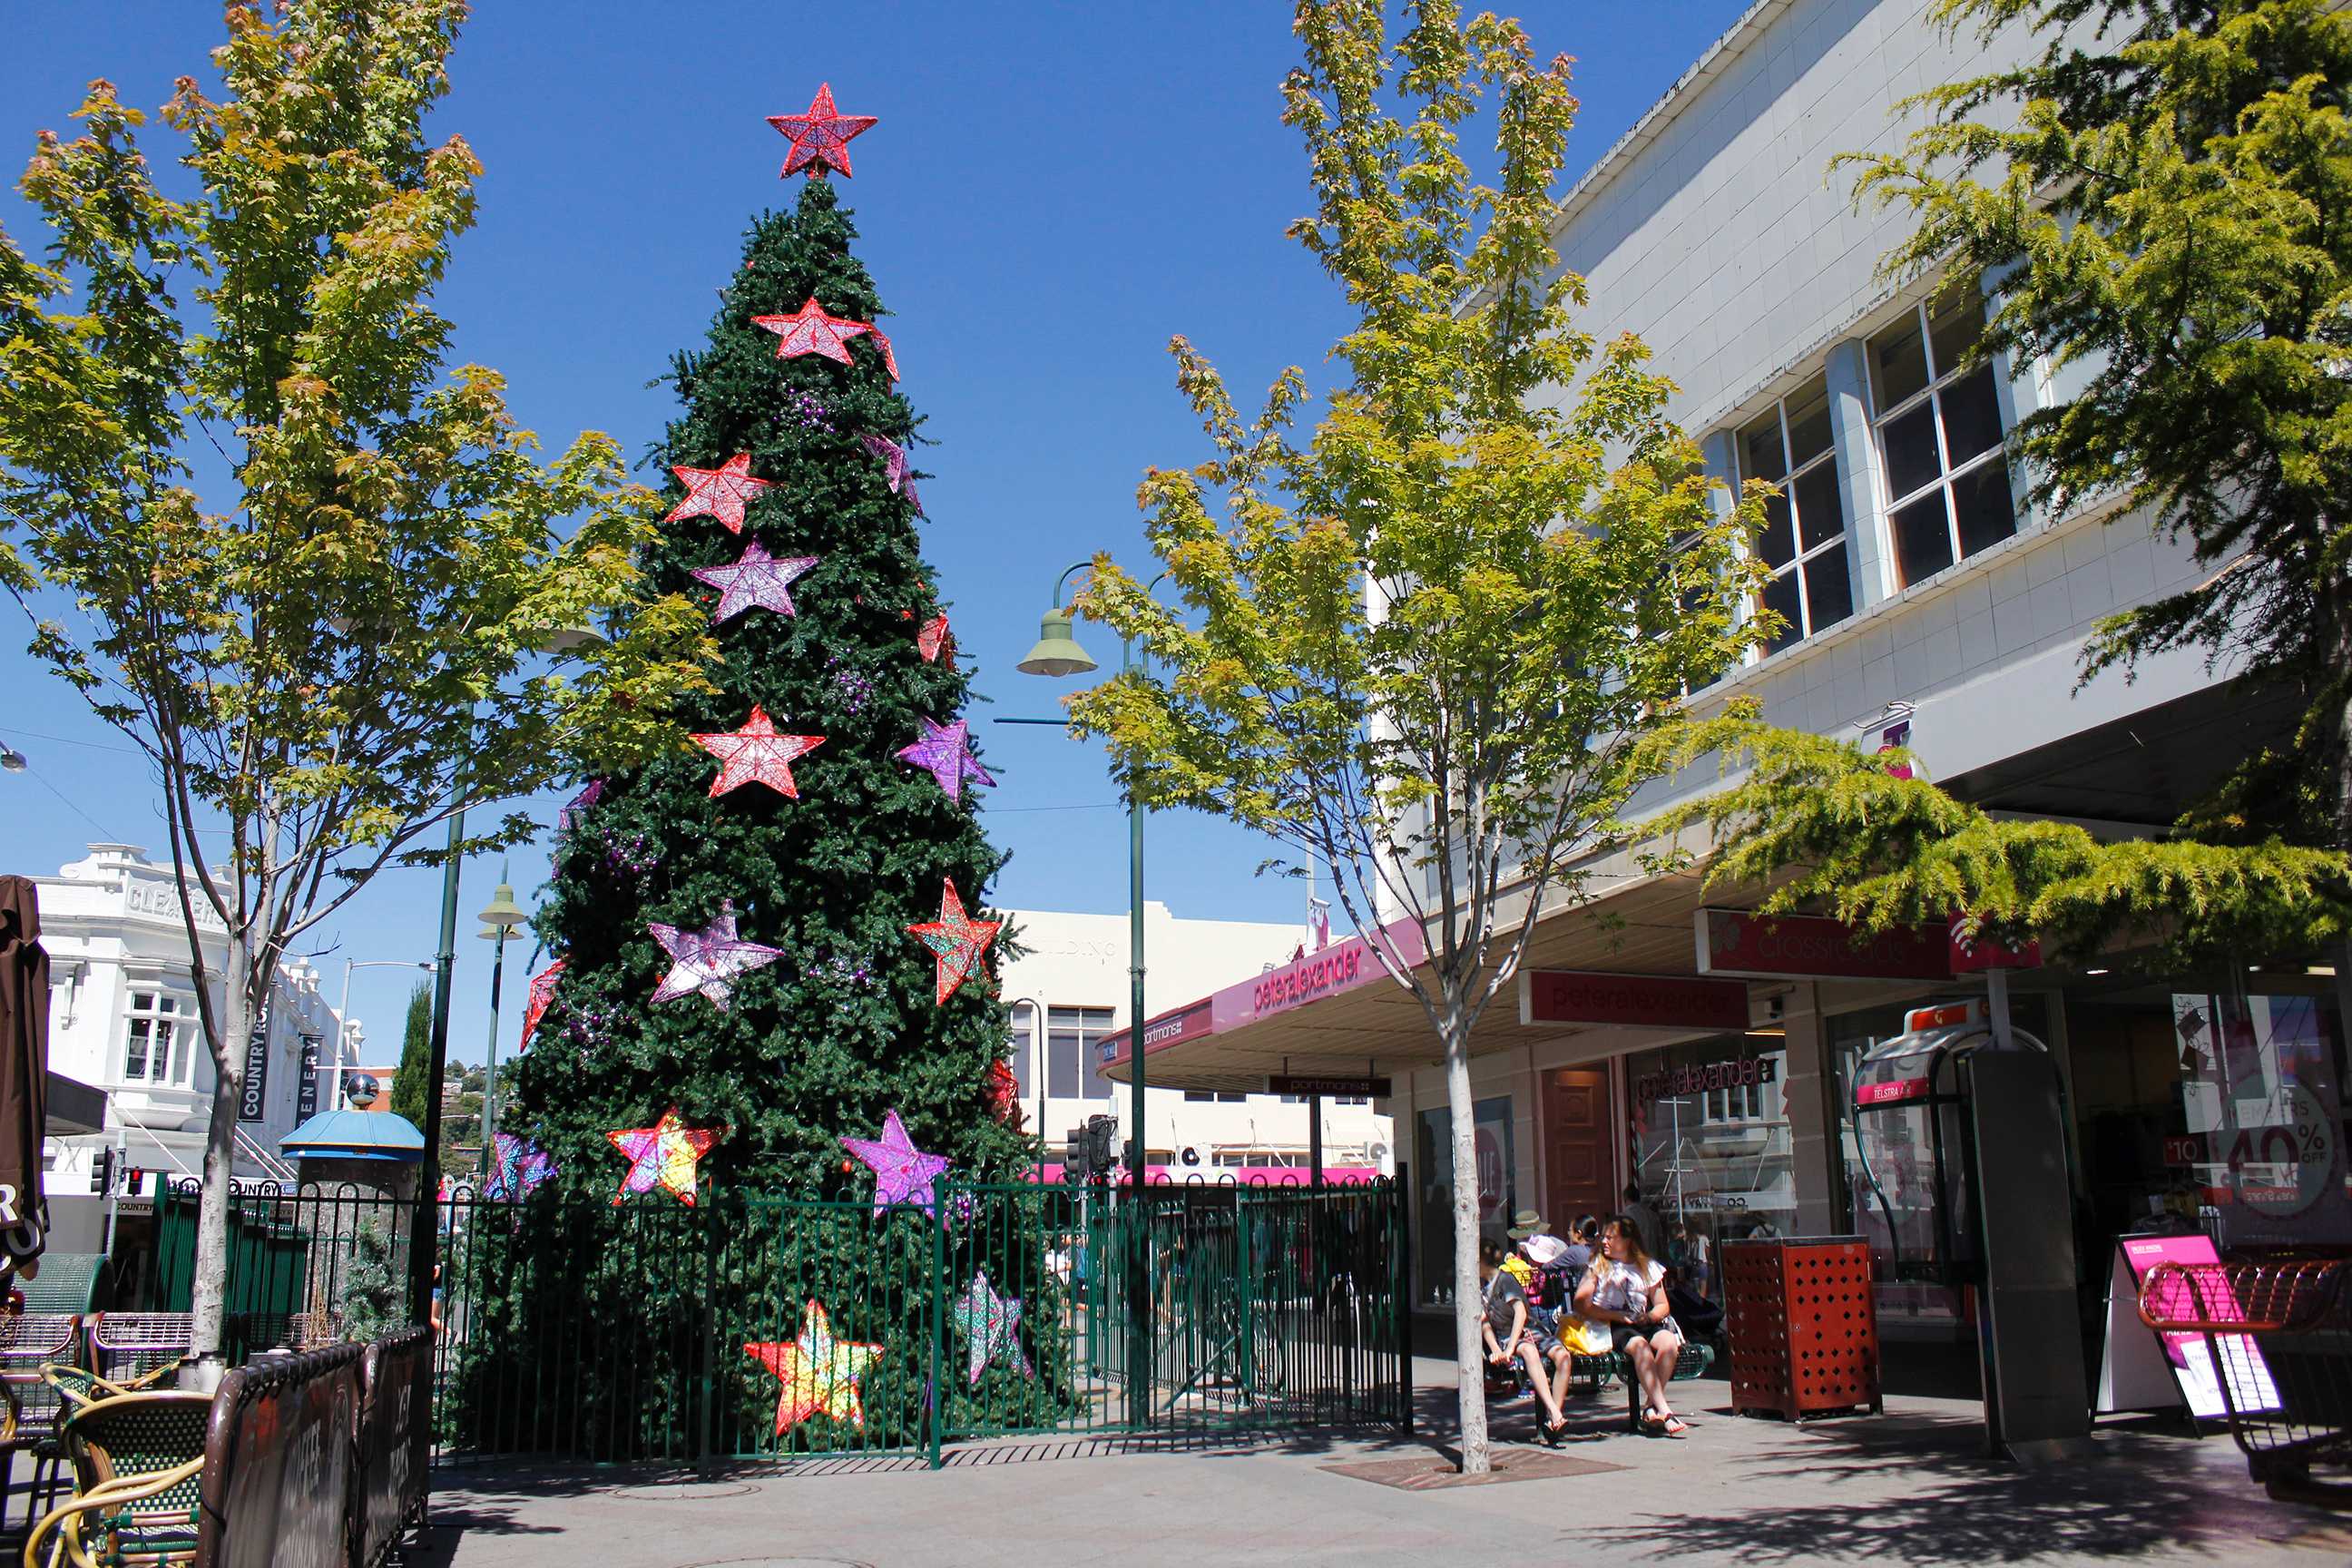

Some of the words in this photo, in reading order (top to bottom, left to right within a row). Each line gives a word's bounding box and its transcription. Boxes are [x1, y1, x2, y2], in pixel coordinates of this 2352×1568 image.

[1254, 944, 1363, 1016] peteralexander
[1143, 1024, 1178, 1045] ortmans
[244, 1035, 265, 1116] COUNTRY
[1874, 1086, 1899, 1100] TELSTRA
[2301, 1152, 2328, 1164] OFF
[229, 1182, 278, 1196] OUNTRY
